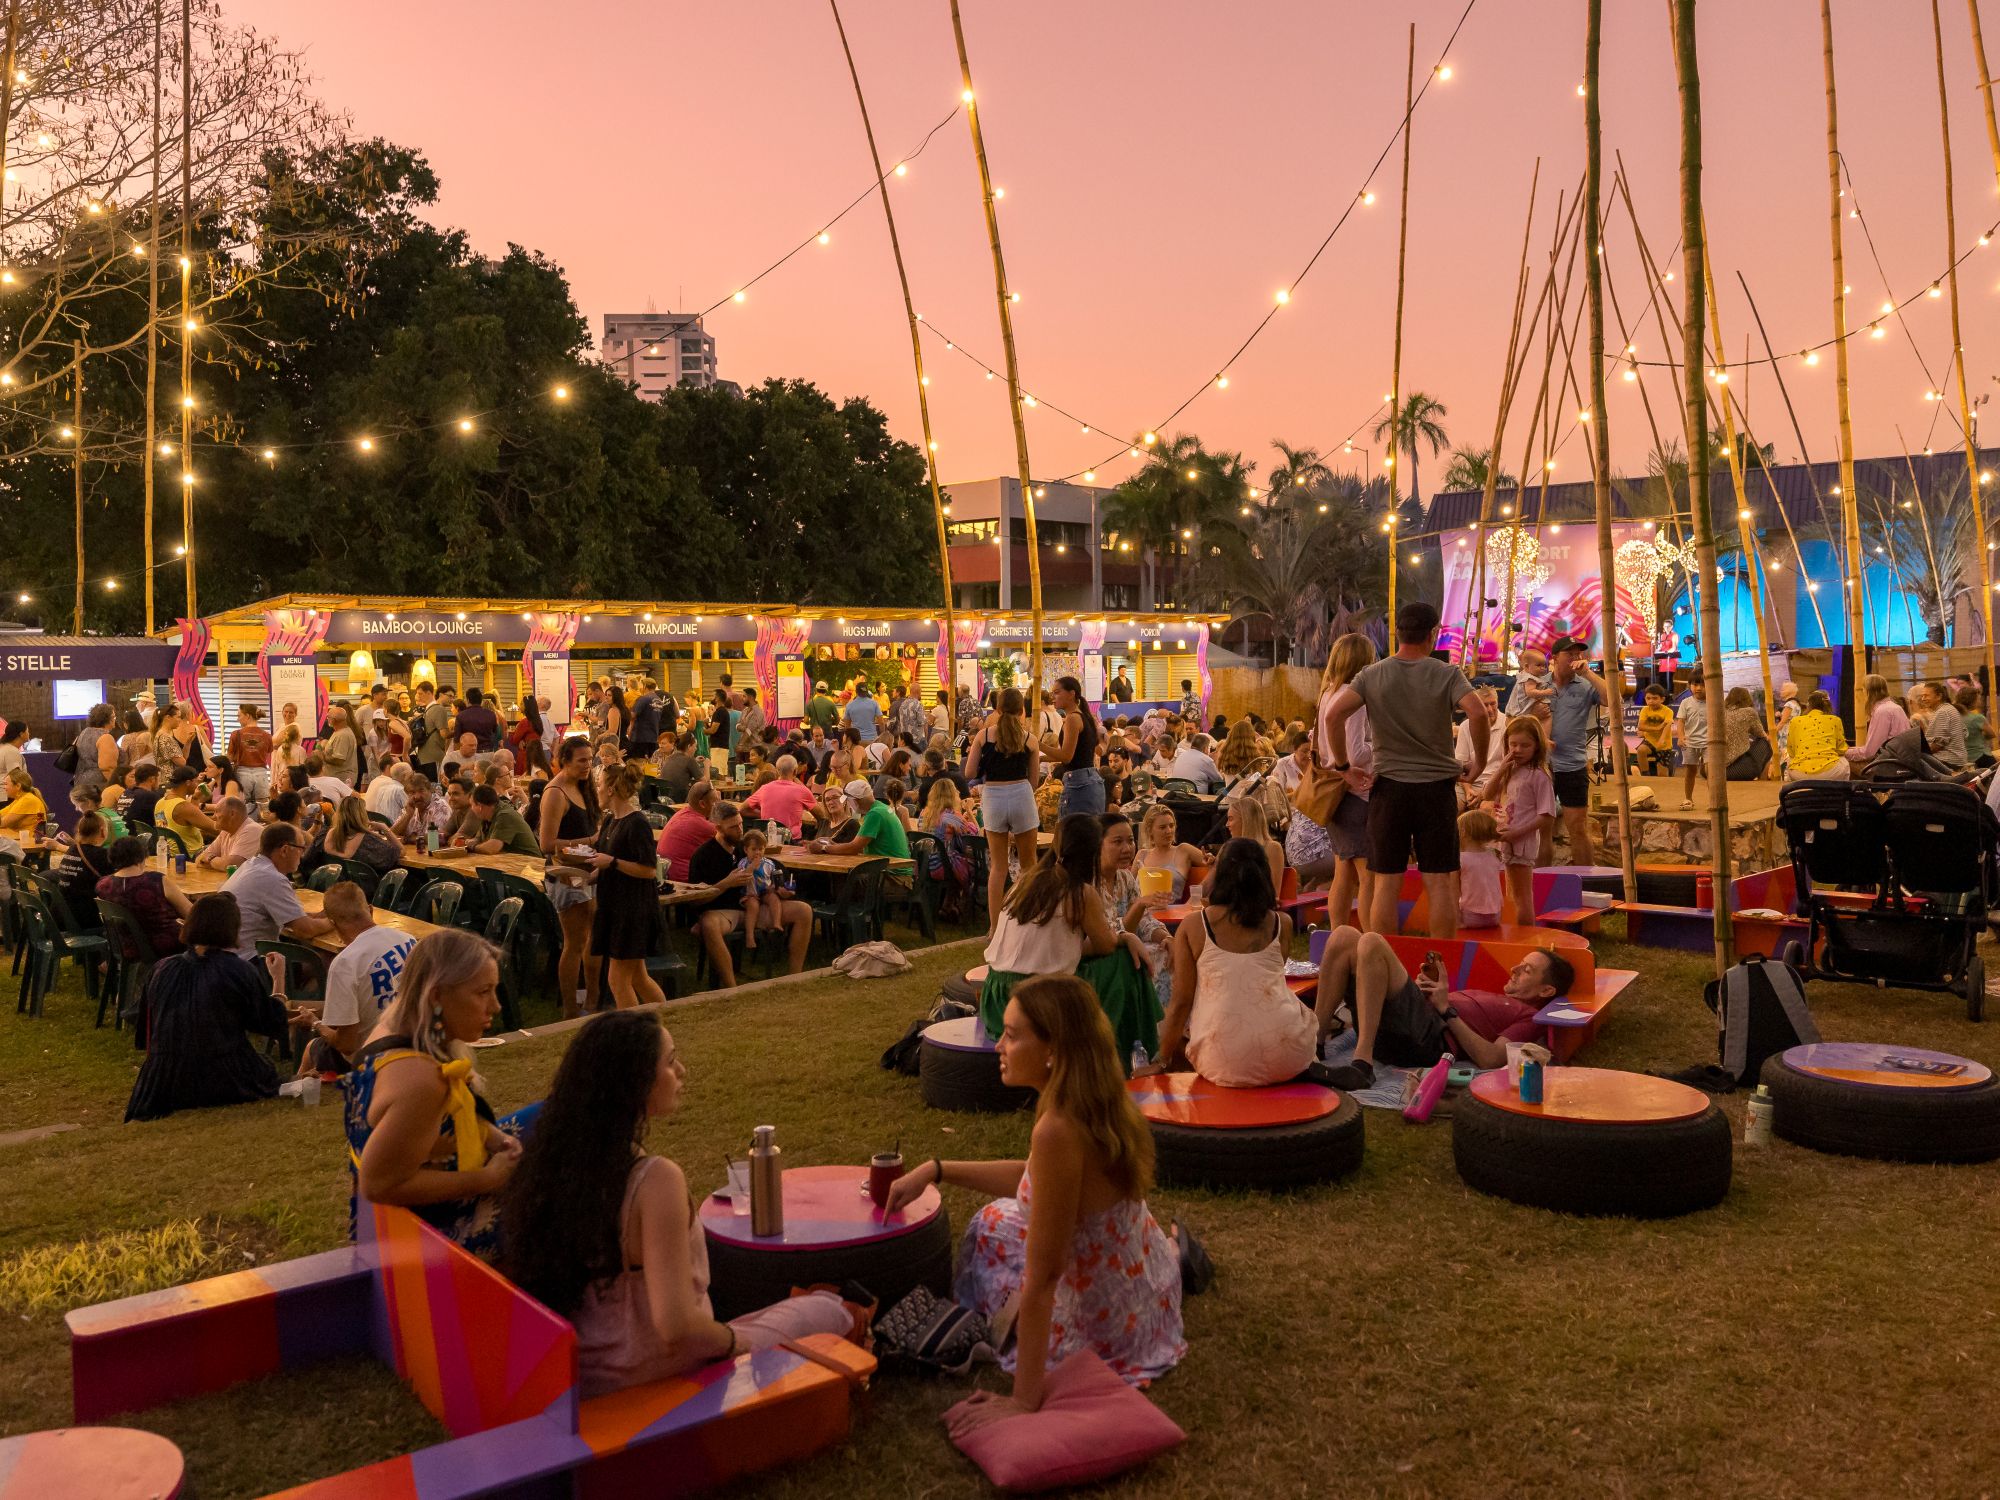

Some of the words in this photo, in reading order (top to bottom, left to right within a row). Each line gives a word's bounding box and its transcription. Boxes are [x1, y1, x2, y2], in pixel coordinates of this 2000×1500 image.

[362, 620, 426, 634] BAMBOO
[428, 620, 483, 635] LOUNGE
[633, 623, 698, 635] TRAMPOLINE
[842, 626, 866, 637] HUGS
[989, 626, 1028, 637] CHRISTINE'S
[1028, 626, 1053, 637] ETIC
[1053, 626, 1069, 637] EATS
[7, 655, 71, 671] STELLE
